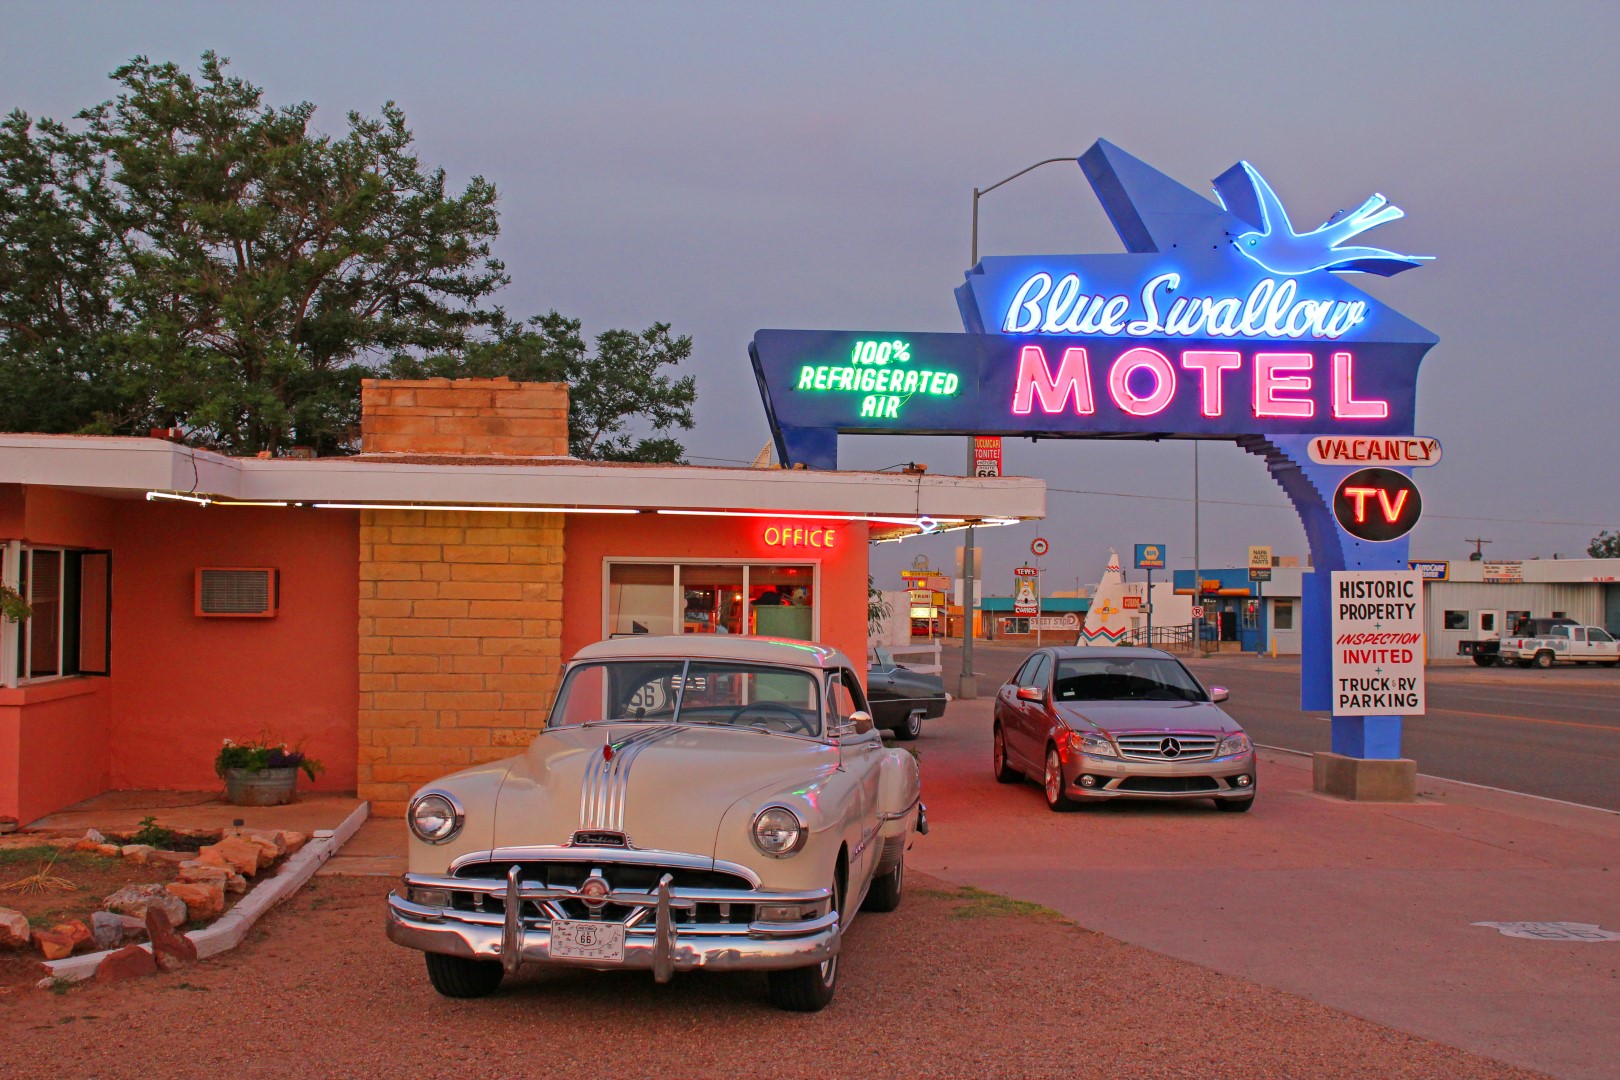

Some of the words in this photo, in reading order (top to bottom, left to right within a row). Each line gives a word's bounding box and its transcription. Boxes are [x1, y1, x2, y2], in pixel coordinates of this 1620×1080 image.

[1004, 273, 1130, 336] Blue
[1127, 271, 1367, 340] Swallow
[852, 340, 911, 364] 100%
[798, 365, 959, 396] REFRIGERATED
[1011, 345, 1389, 416] MOTEL
[860, 395, 900, 419] AIR
[974, 449, 1000, 459] TONITE!
[1316, 435, 1440, 460] VACANCY
[1344, 487, 1408, 522] TV
[764, 527, 836, 548] OFFICE
[1339, 580, 1414, 599] HISTORIC
[1339, 603, 1416, 621] PROPERTY
[1336, 633, 1421, 646] INSPECTION
[1343, 649, 1413, 664] INVITED
[1339, 678, 1390, 692] TRUCK
[1391, 679, 1397, 688] &
[1398, 677, 1417, 691] RV
[1339, 693, 1419, 709] PARKING
[580, 935, 592, 943] 66
